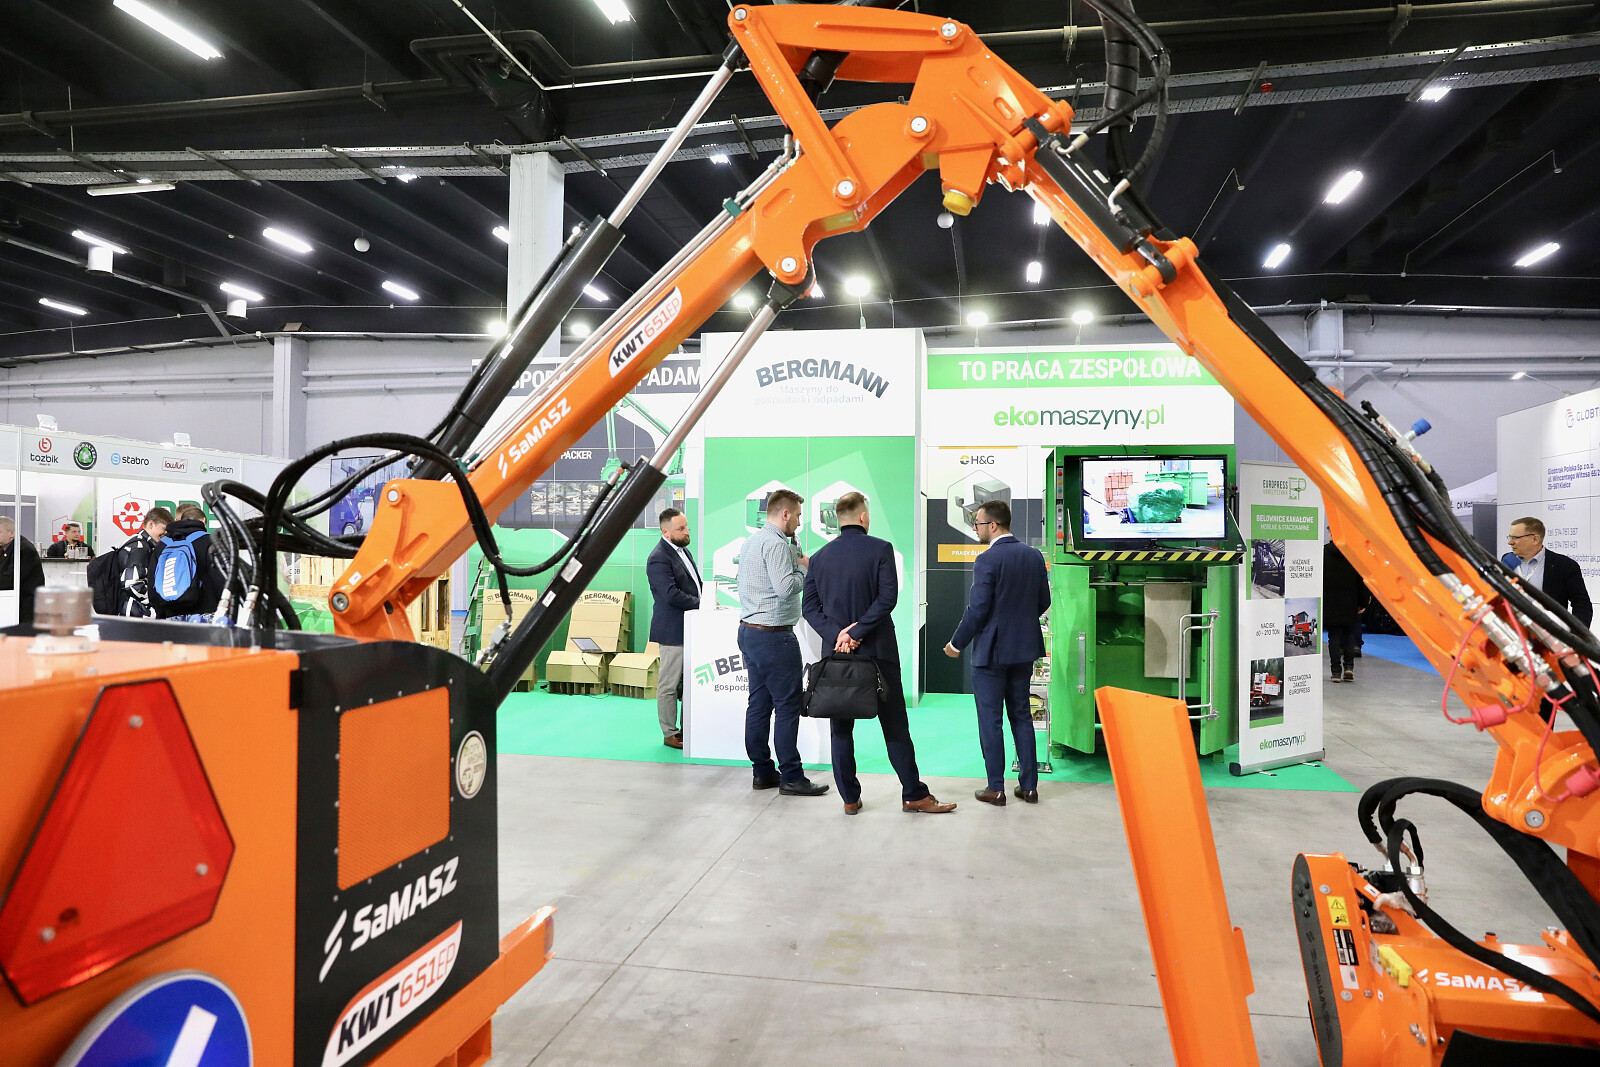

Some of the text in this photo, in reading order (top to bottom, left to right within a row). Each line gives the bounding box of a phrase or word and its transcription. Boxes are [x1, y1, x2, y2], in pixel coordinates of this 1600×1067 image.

[957, 356, 1202, 381] TO PRACA ZESPOŁOWA
[755, 358, 890, 398] BERGMANN
[780, 385, 839, 395] Maszyny do
[814, 394, 865, 405] odpadami
[994, 404, 1165, 430] ekomaszyny.pl
[1577, 407, 1600, 422] GLOBT
[508, 397, 572, 464] SaMASZ
[30, 453, 59, 464] tozbik
[121, 455, 150, 466] stabro
[970, 455, 995, 465] H&G
[208, 465, 234, 474] ekotech
[1262, 479, 1289, 490] EUROPRESS
[1256, 514, 1314, 523] BELOWNICE KANAŁOWE
[162, 557, 177, 598] PUMA
[584, 592, 621, 604] BERGMANN
[735, 675, 749, 683] Ma
[714, 683, 750, 692] gospoda
[1288, 687, 1311, 696] EUROPRESS
[1259, 732, 1307, 750] ekomaszyny.pl
[350, 856, 459, 951] SaMASZ
